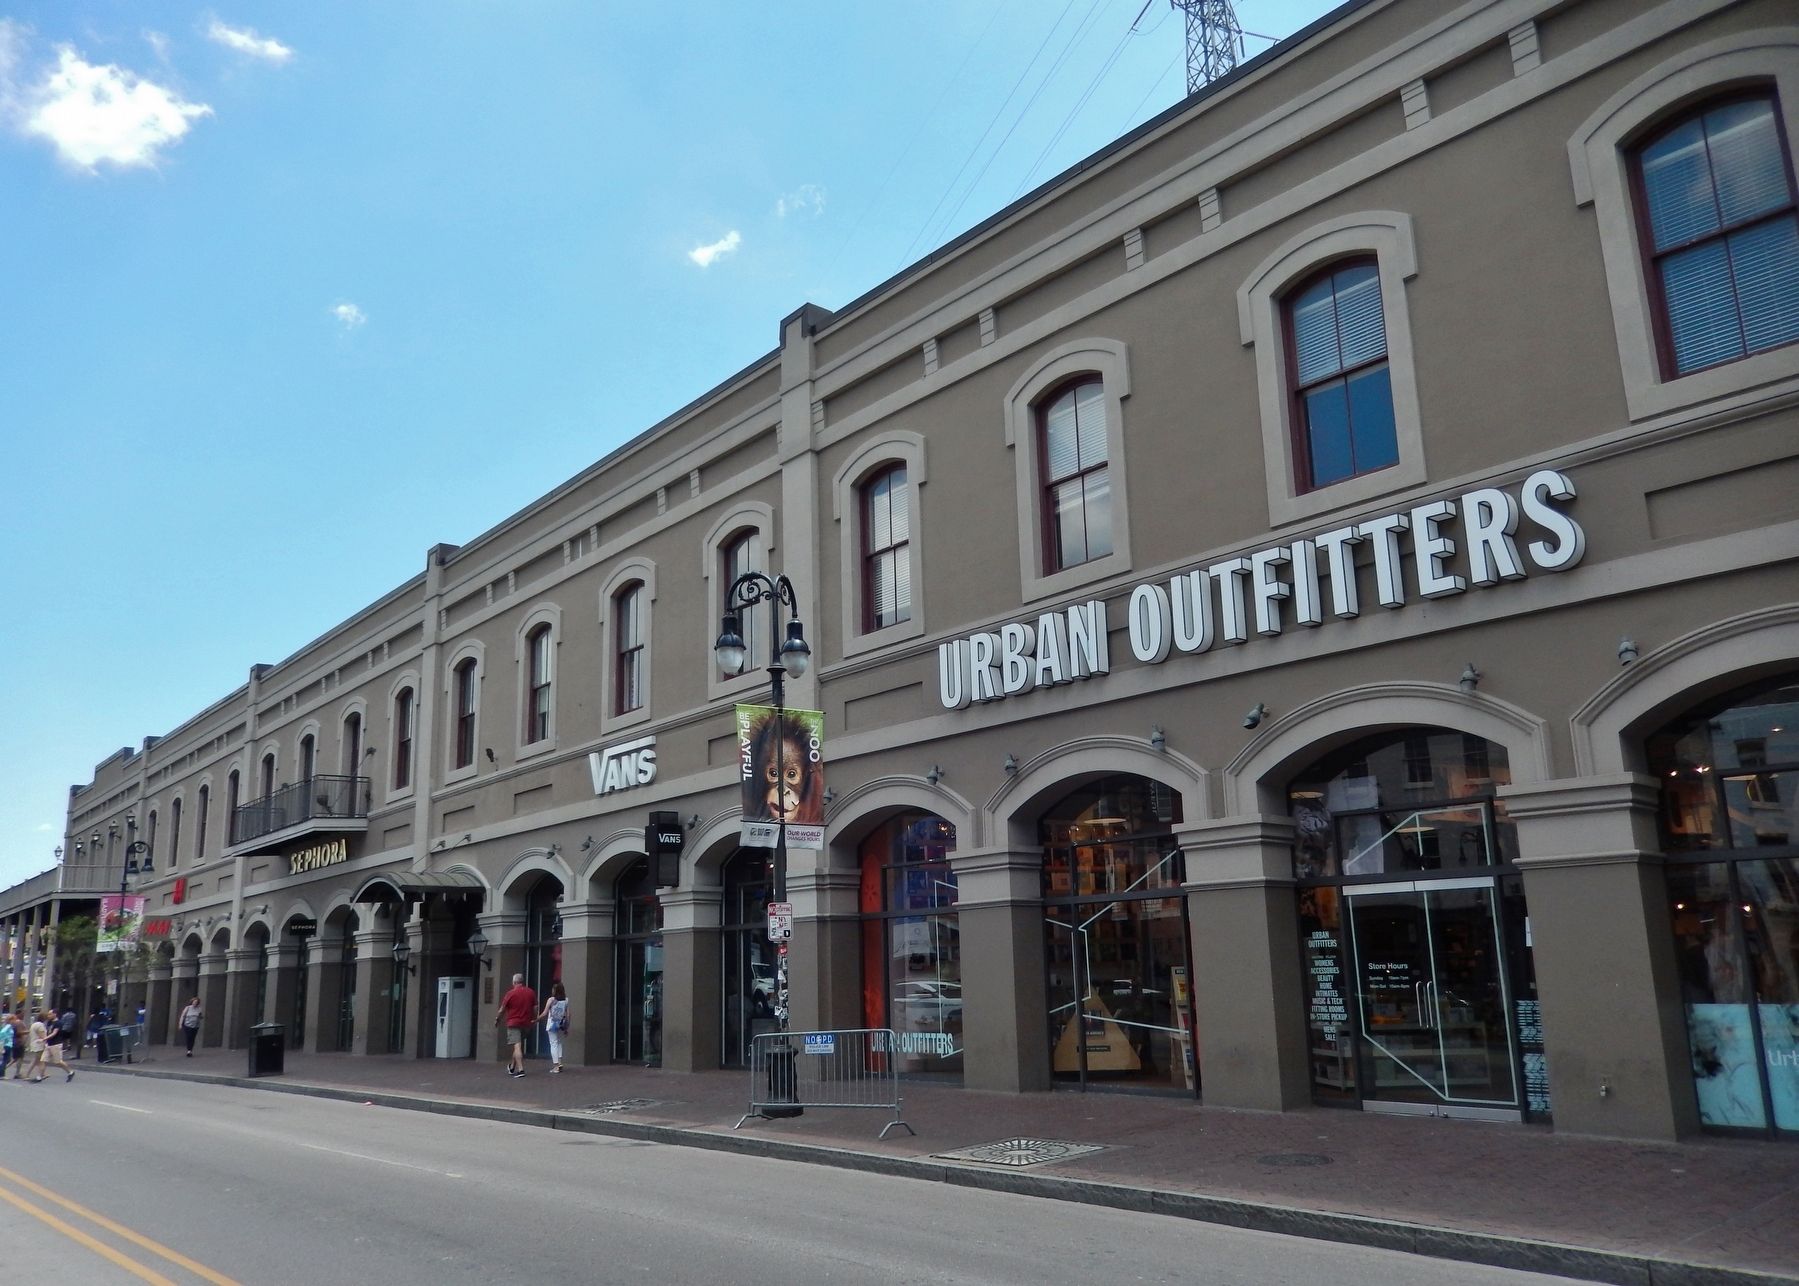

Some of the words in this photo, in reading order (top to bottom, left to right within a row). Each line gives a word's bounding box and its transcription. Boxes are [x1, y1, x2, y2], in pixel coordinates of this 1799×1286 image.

[939, 600, 1110, 709] URBAN
[1128, 470, 1586, 665] OUTFITTERS
[740, 719, 753, 781] PLAYFUL
[589, 735, 657, 795] VANS
[658, 833, 681, 844] VANS
[289, 838, 347, 875] SEPHORA
[1308, 940, 1337, 948] OUTFITTERS
[1312, 931, 1329, 939] URBAN
[1368, 962, 1386, 970] Store
[902, 1032, 953, 1054] OUTFITTERS
